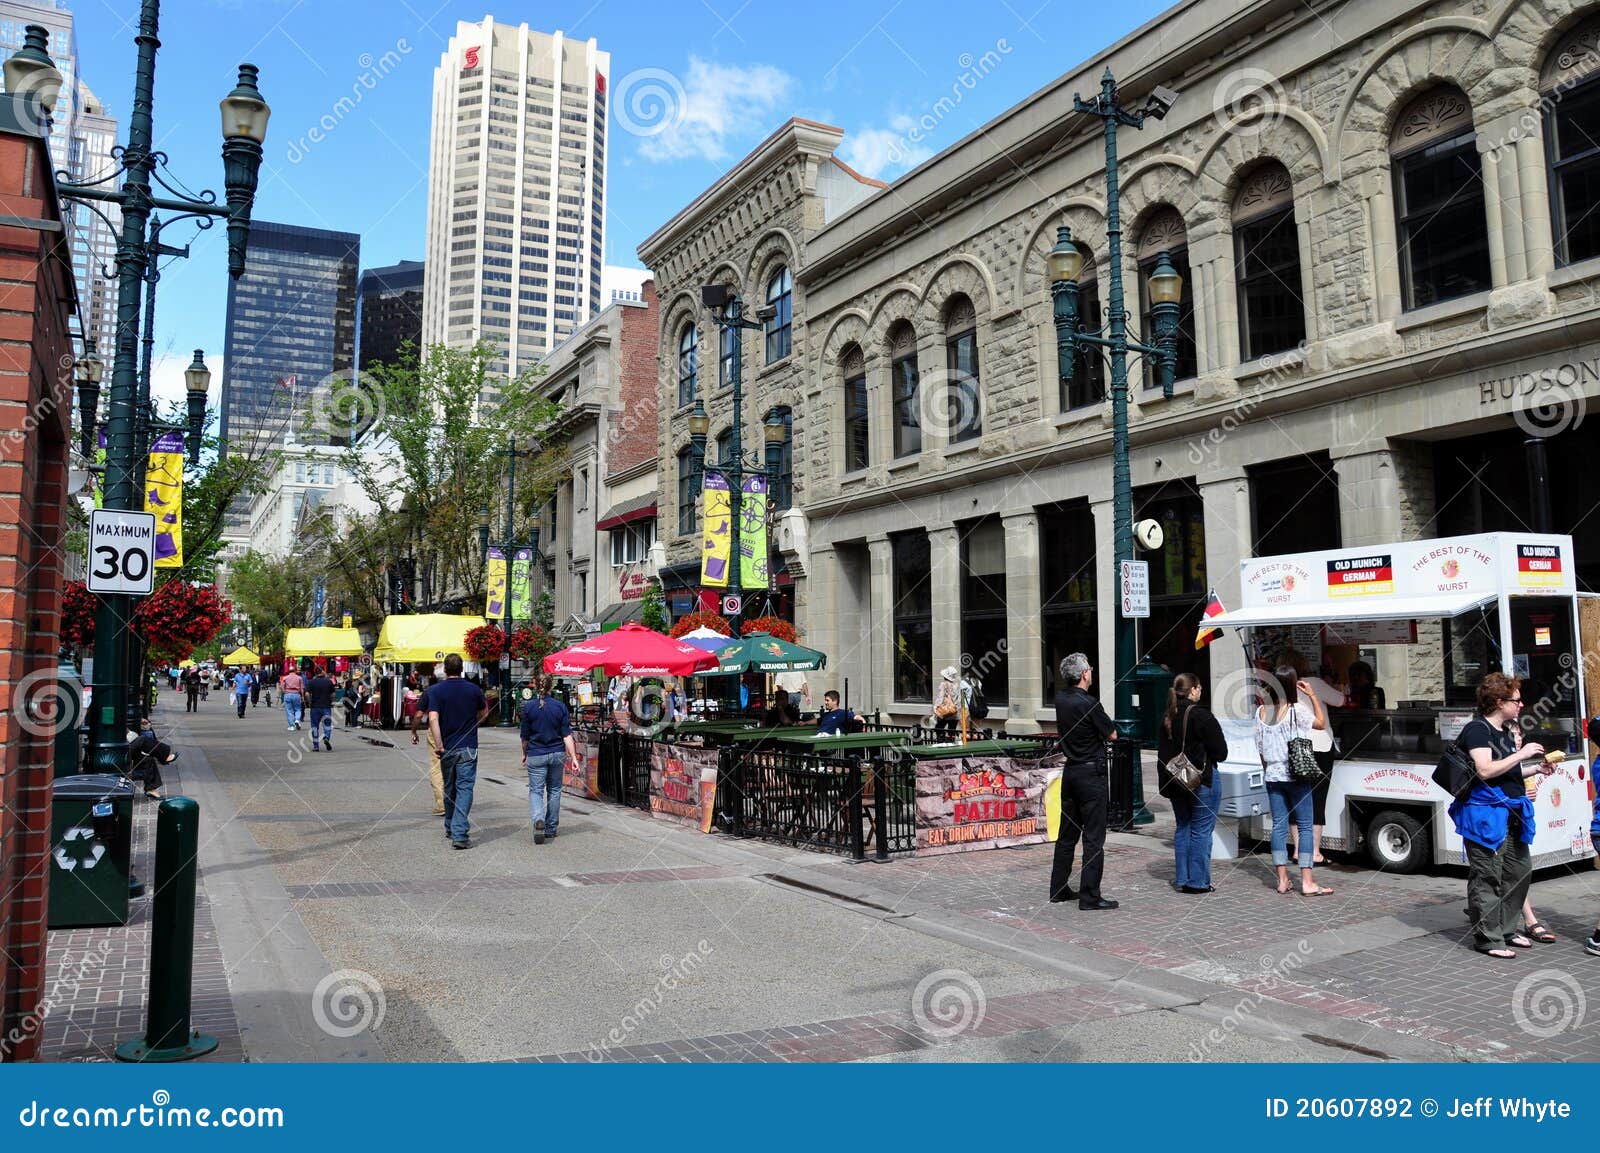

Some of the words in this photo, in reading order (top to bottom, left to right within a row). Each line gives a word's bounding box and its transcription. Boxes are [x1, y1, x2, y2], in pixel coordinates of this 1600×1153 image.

[1479, 357, 1600, 405] HUDSON
[96, 523, 150, 538] MAXIMUM
[92, 545, 149, 581] 30
[1335, 559, 1351, 571] OLD
[1351, 557, 1383, 569] MUNICH
[1412, 555, 1430, 571] THE
[1430, 546, 1454, 559] BEST
[1456, 545, 1470, 555] OF
[1472, 549, 1492, 565] THE
[1248, 571, 1261, 585] THE
[1261, 563, 1280, 575] BEST
[1282, 563, 1293, 571] OF
[1294, 566, 1310, 581] THE
[1342, 571, 1377, 582] GERMAN
[1437, 581, 1469, 591] WURST
[1267, 594, 1291, 603] WURST
[621, 662, 669, 674] Budweiser
[760, 662, 788, 670] ALEXANDER
[1364, 773, 1375, 783] THE
[1375, 769, 1388, 778] BEST
[1389, 768, 1397, 776] OF
[1398, 769, 1408, 778] THE
[954, 800, 1017, 823] PATIO
[949, 824, 976, 842] DRINK
[978, 823, 996, 840] AND
[997, 823, 1009, 837] BE
[1011, 818, 1038, 836] MERRY
[1548, 819, 1567, 829] WURST
